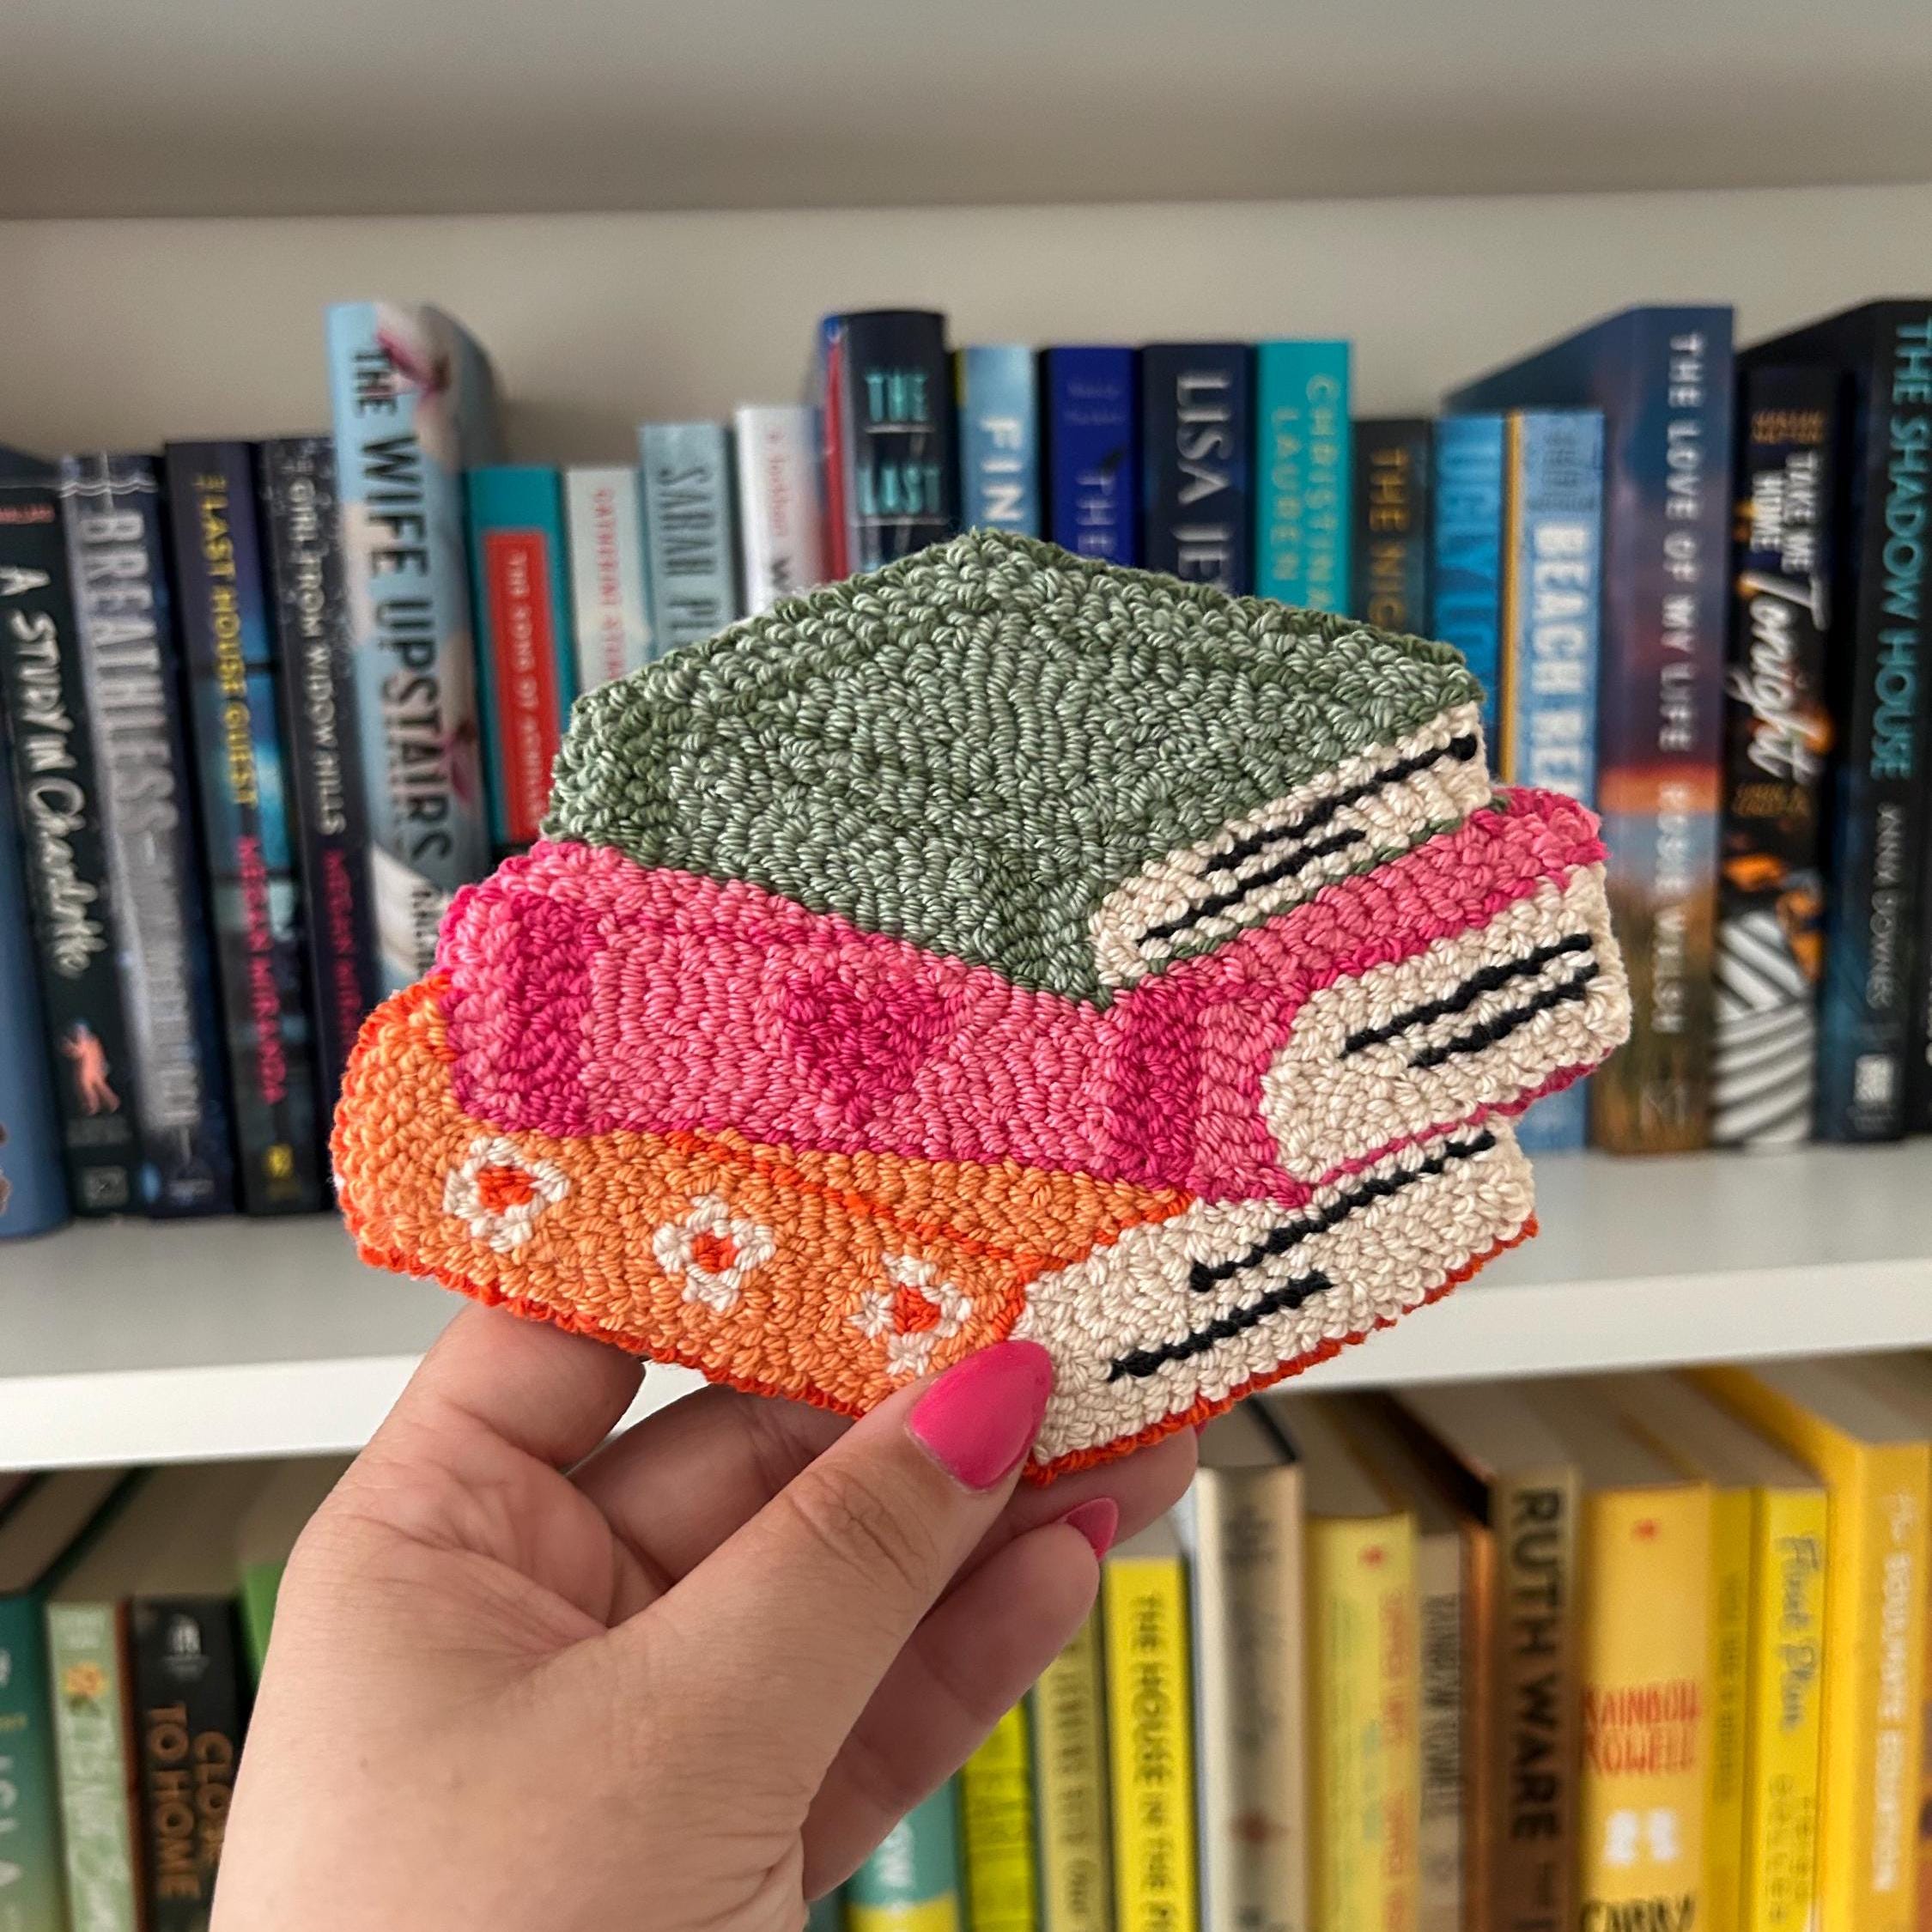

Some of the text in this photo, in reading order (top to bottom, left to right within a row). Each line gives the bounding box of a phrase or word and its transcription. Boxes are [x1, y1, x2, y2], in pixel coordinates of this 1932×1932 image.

[351, 343, 400, 419] THE
[864, 371, 929, 424] THE
[359, 434, 429, 578] WIFE
[657, 464, 718, 577] SARAH
[859, 461, 942, 516] LAST
[980, 415, 1024, 530] FIN
[1170, 371, 1234, 588] LISA JE
[1270, 406, 1303, 581] LAUREN
[1304, 372, 1342, 611] CHRISTINA
[1369, 446, 1410, 532] THE
[1783, 449, 1819, 523] TAKE
[0, 564, 52, 597] A
[198, 494, 236, 578] LAST
[1657, 330, 1704, 752] THE LOVE OF MY LIFE
[1871, 318, 1932, 779] THE SHADOW HOUSE
[210, 584, 247, 697] HOUSE
[1531, 525, 1591, 695] BEACH
[9, 609, 75, 733] STUDY
[303, 642, 337, 747] WIDOW
[375, 598, 453, 863] UPSTAIRS
[1724, 568, 1832, 784] Tonight
[24, 734, 78, 773] IN
[222, 700, 258, 809] GUEST
[313, 750, 347, 836] HILLS
[27, 775, 107, 980] Charlotte
[1130, 1659, 1176, 1785] HOUSE
[1509, 1487, 1563, 1840] RUTH WARE
[147, 1701, 202, 1901] TO HOME
